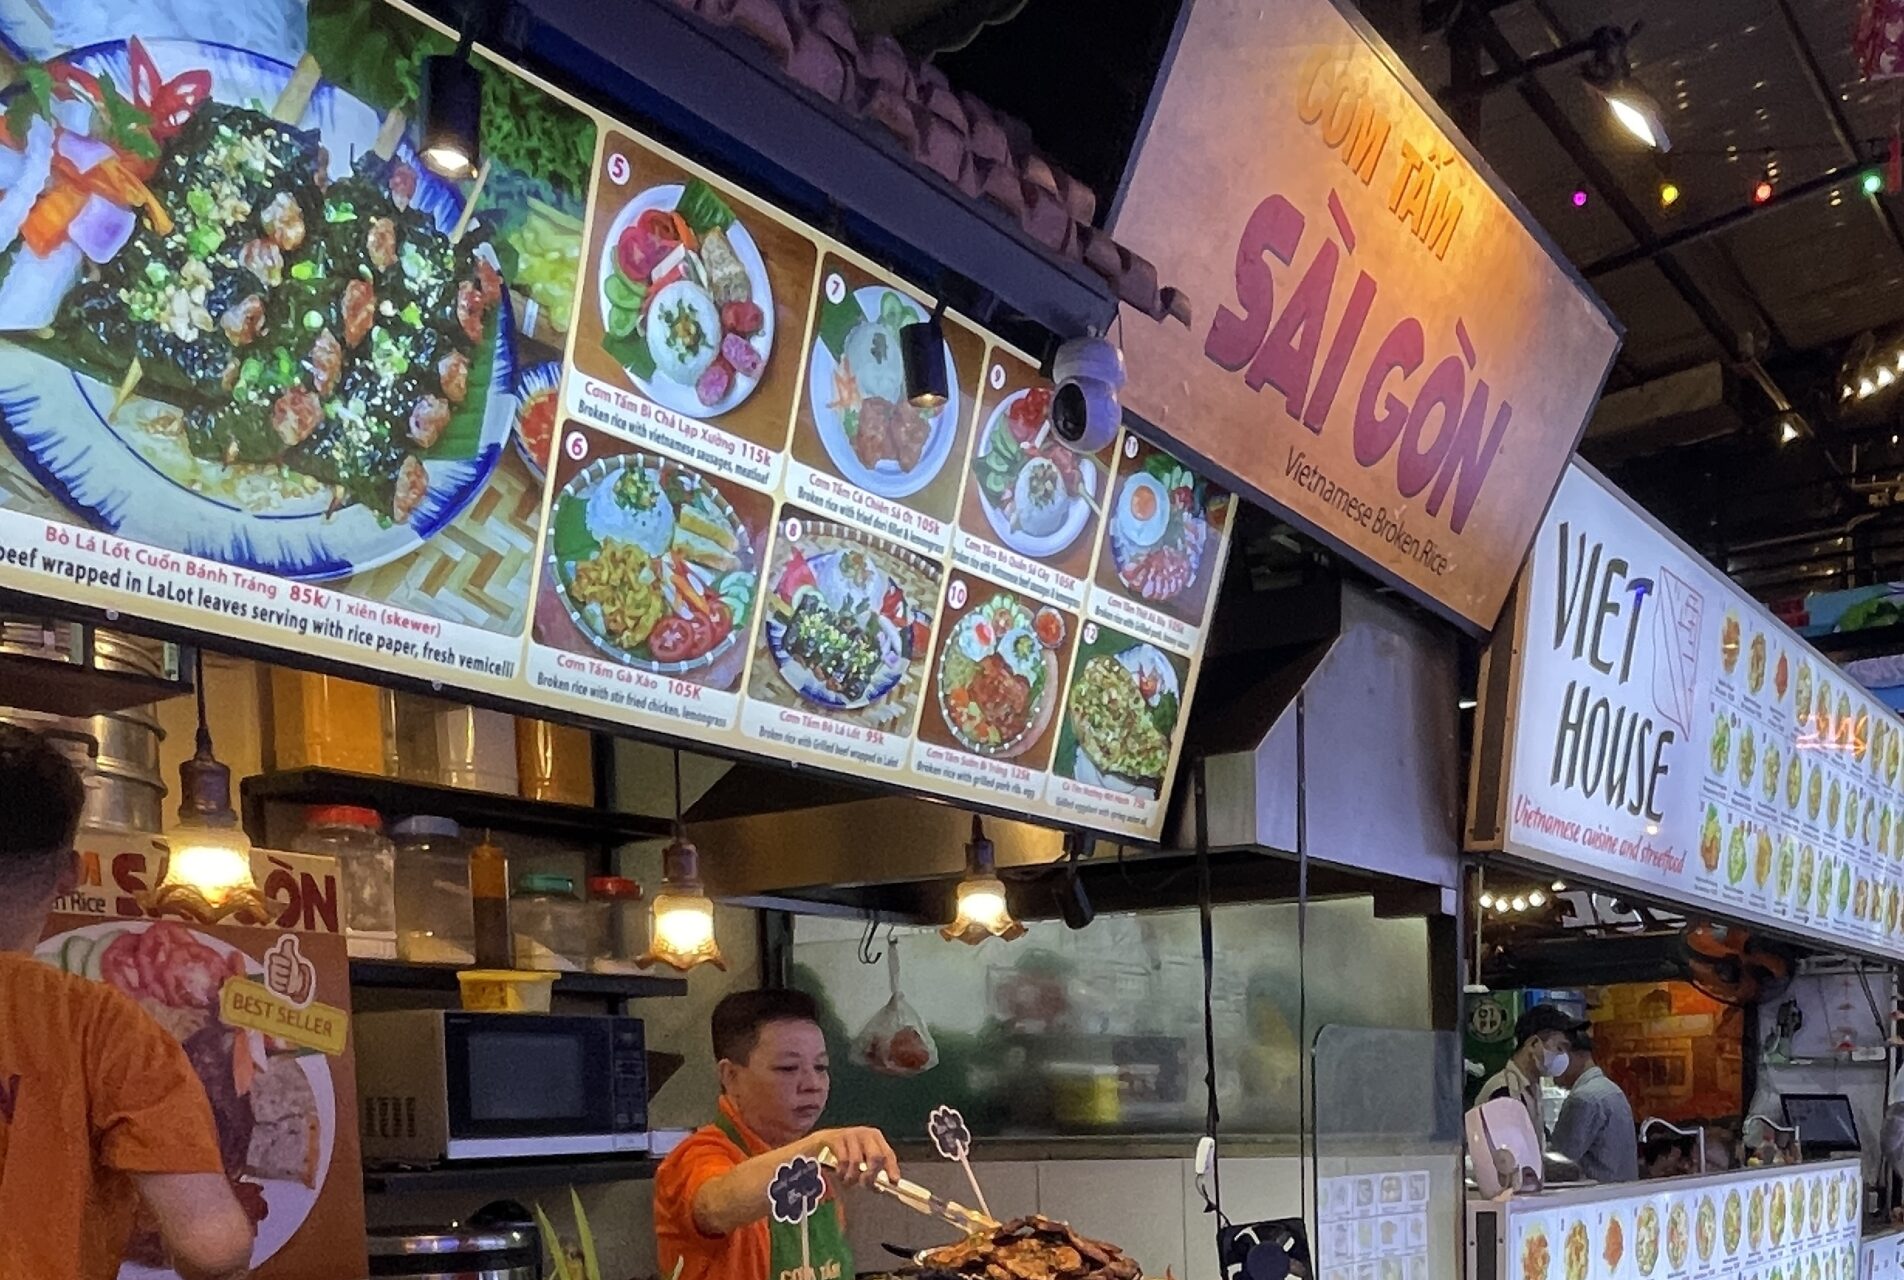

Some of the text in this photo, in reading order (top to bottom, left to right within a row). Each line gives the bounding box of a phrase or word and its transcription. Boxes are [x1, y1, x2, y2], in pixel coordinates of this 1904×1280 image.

[611, 156, 625, 178] 5
[831, 280, 841, 297] 7
[1204, 188, 1513, 536] SÀI GÒN
[578, 399, 610, 424] Broken
[611, 412, 627, 431] rice
[628, 420, 647, 439] with
[572, 437, 584, 456] 6
[788, 523, 798, 537] 8
[1285, 445, 1449, 577] Vietnamese Broken Rice
[45, 526, 70, 545] Bò
[75, 533, 96, 551] Lá
[102, 539, 131, 562] Lốt
[135, 549, 181, 573] Cuốn
[186, 561, 228, 584] Bánh
[336, 599, 342, 612] 1
[381, 609, 442, 638] (skewer)
[951, 586, 965, 604] 10
[1553, 522, 1654, 685] VIET
[42, 554, 121, 588] wrapped
[126, 571, 142, 593] in
[147, 576, 194, 606] LaLot
[198, 588, 248, 617] leaves
[251, 604, 308, 635] serving
[312, 617, 344, 639] with
[347, 625, 373, 646] rice
[376, 634, 419, 660] paper,
[422, 642, 456, 664] fresh
[537, 671, 570, 692] Broken
[571, 682, 588, 696] rice
[589, 686, 609, 701] with
[626, 693, 647, 710] fried
[556, 654, 586, 673] Cơm
[667, 680, 702, 700] 105K
[1550, 680, 1675, 822] HOUSE
[1514, 794, 1582, 843] Vietnamese
[1619, 835, 1644, 860] and
[71, 890, 106, 913] Rice
[232, 992, 333, 1038] BEST SELLER
